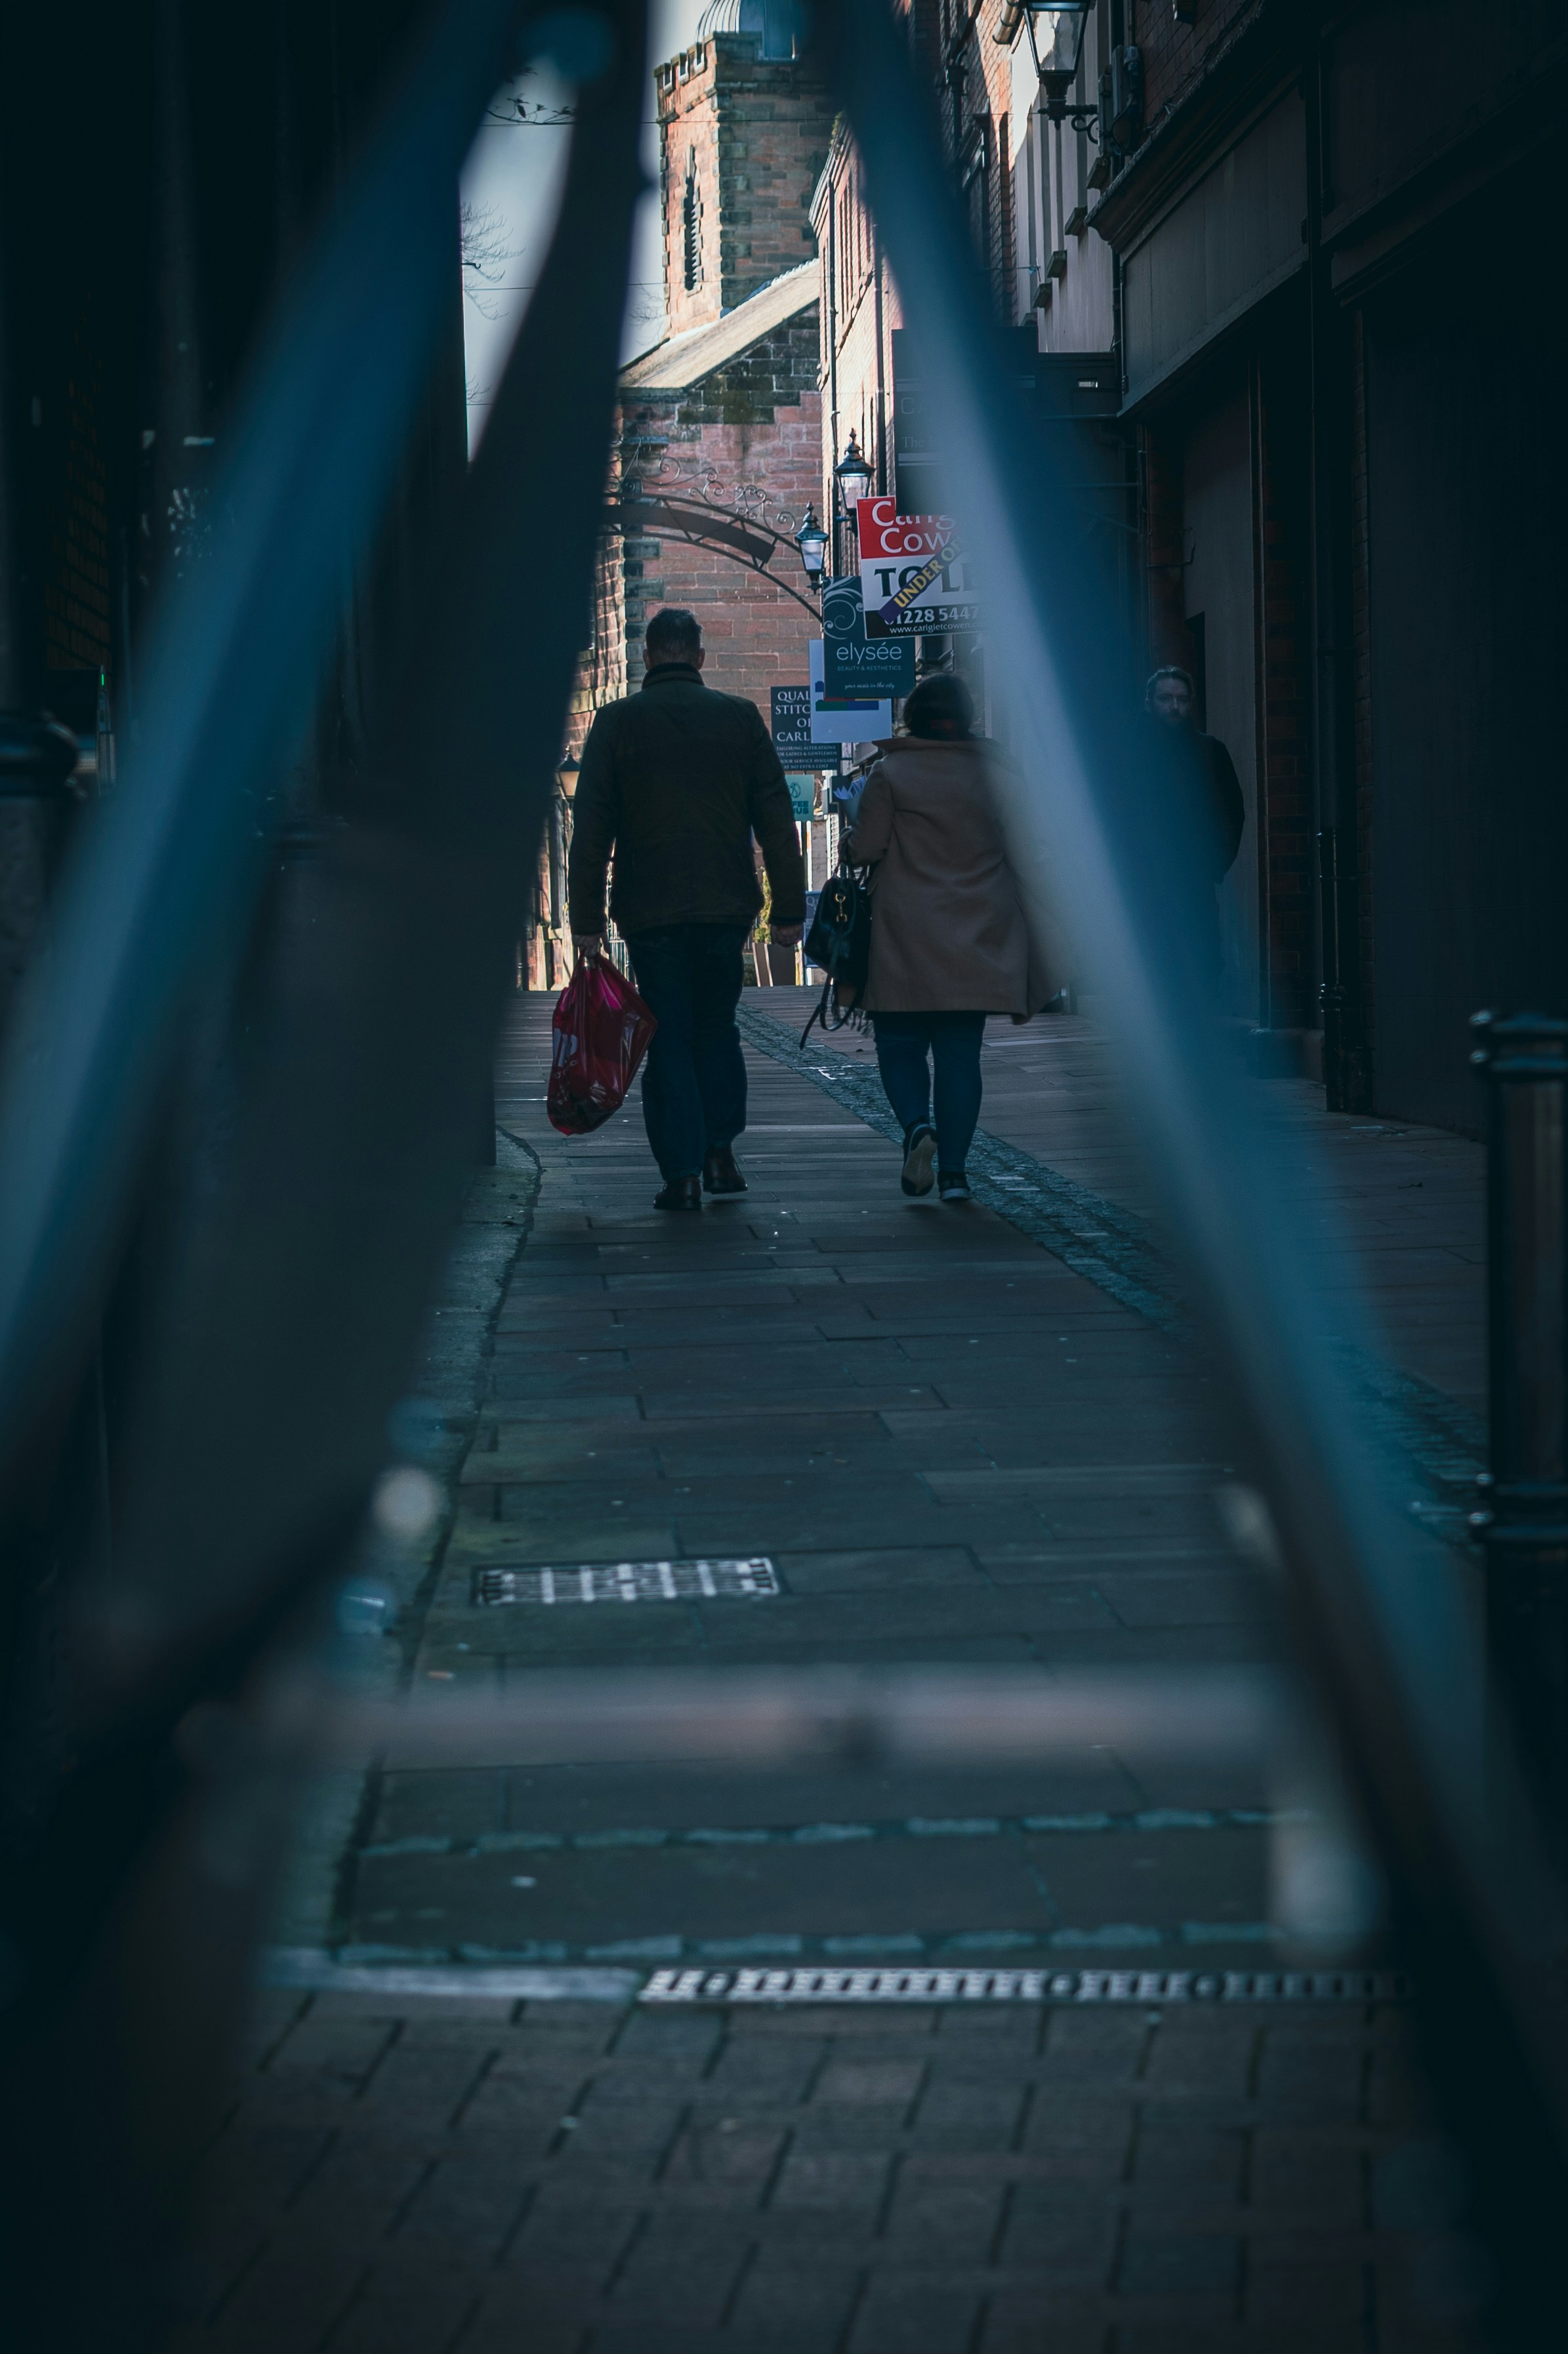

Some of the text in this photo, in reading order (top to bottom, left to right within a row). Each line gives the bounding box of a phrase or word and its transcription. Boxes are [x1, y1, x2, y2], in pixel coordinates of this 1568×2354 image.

[893, 559, 945, 608] UNDER
[884, 608, 935, 625] 1228
[836, 641, 903, 665] elysée
[775, 704, 811, 715] STITC
[776, 731, 810, 742] CARL
